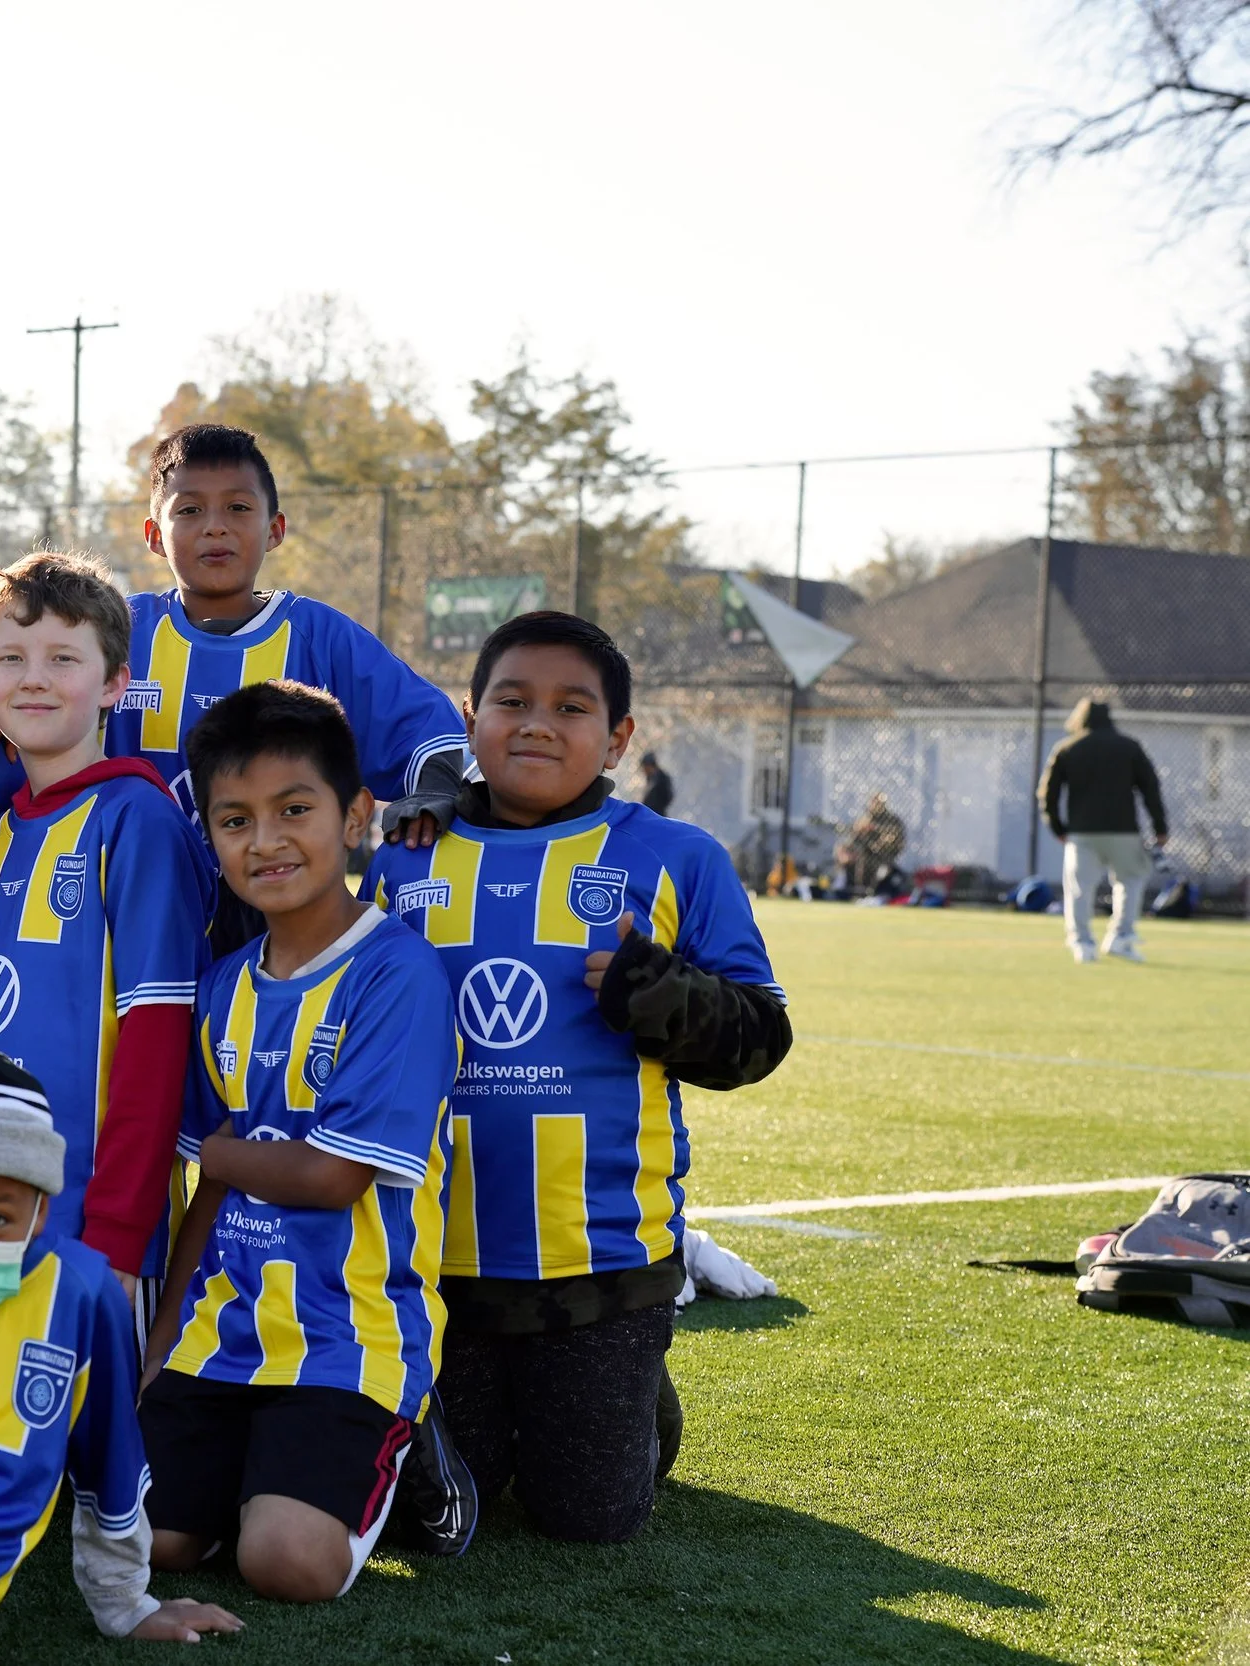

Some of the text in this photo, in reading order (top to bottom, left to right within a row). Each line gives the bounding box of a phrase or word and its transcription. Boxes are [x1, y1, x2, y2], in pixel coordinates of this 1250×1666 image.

[122, 693, 157, 709] ACTIVE
[576, 869, 623, 881] FOUNDATION
[399, 879, 432, 892] OPERATION
[400, 890, 445, 914] ACTIVE
[458, 1062, 564, 1083] olkswagen
[452, 1084, 572, 1096] RKERS FOUNDATION
